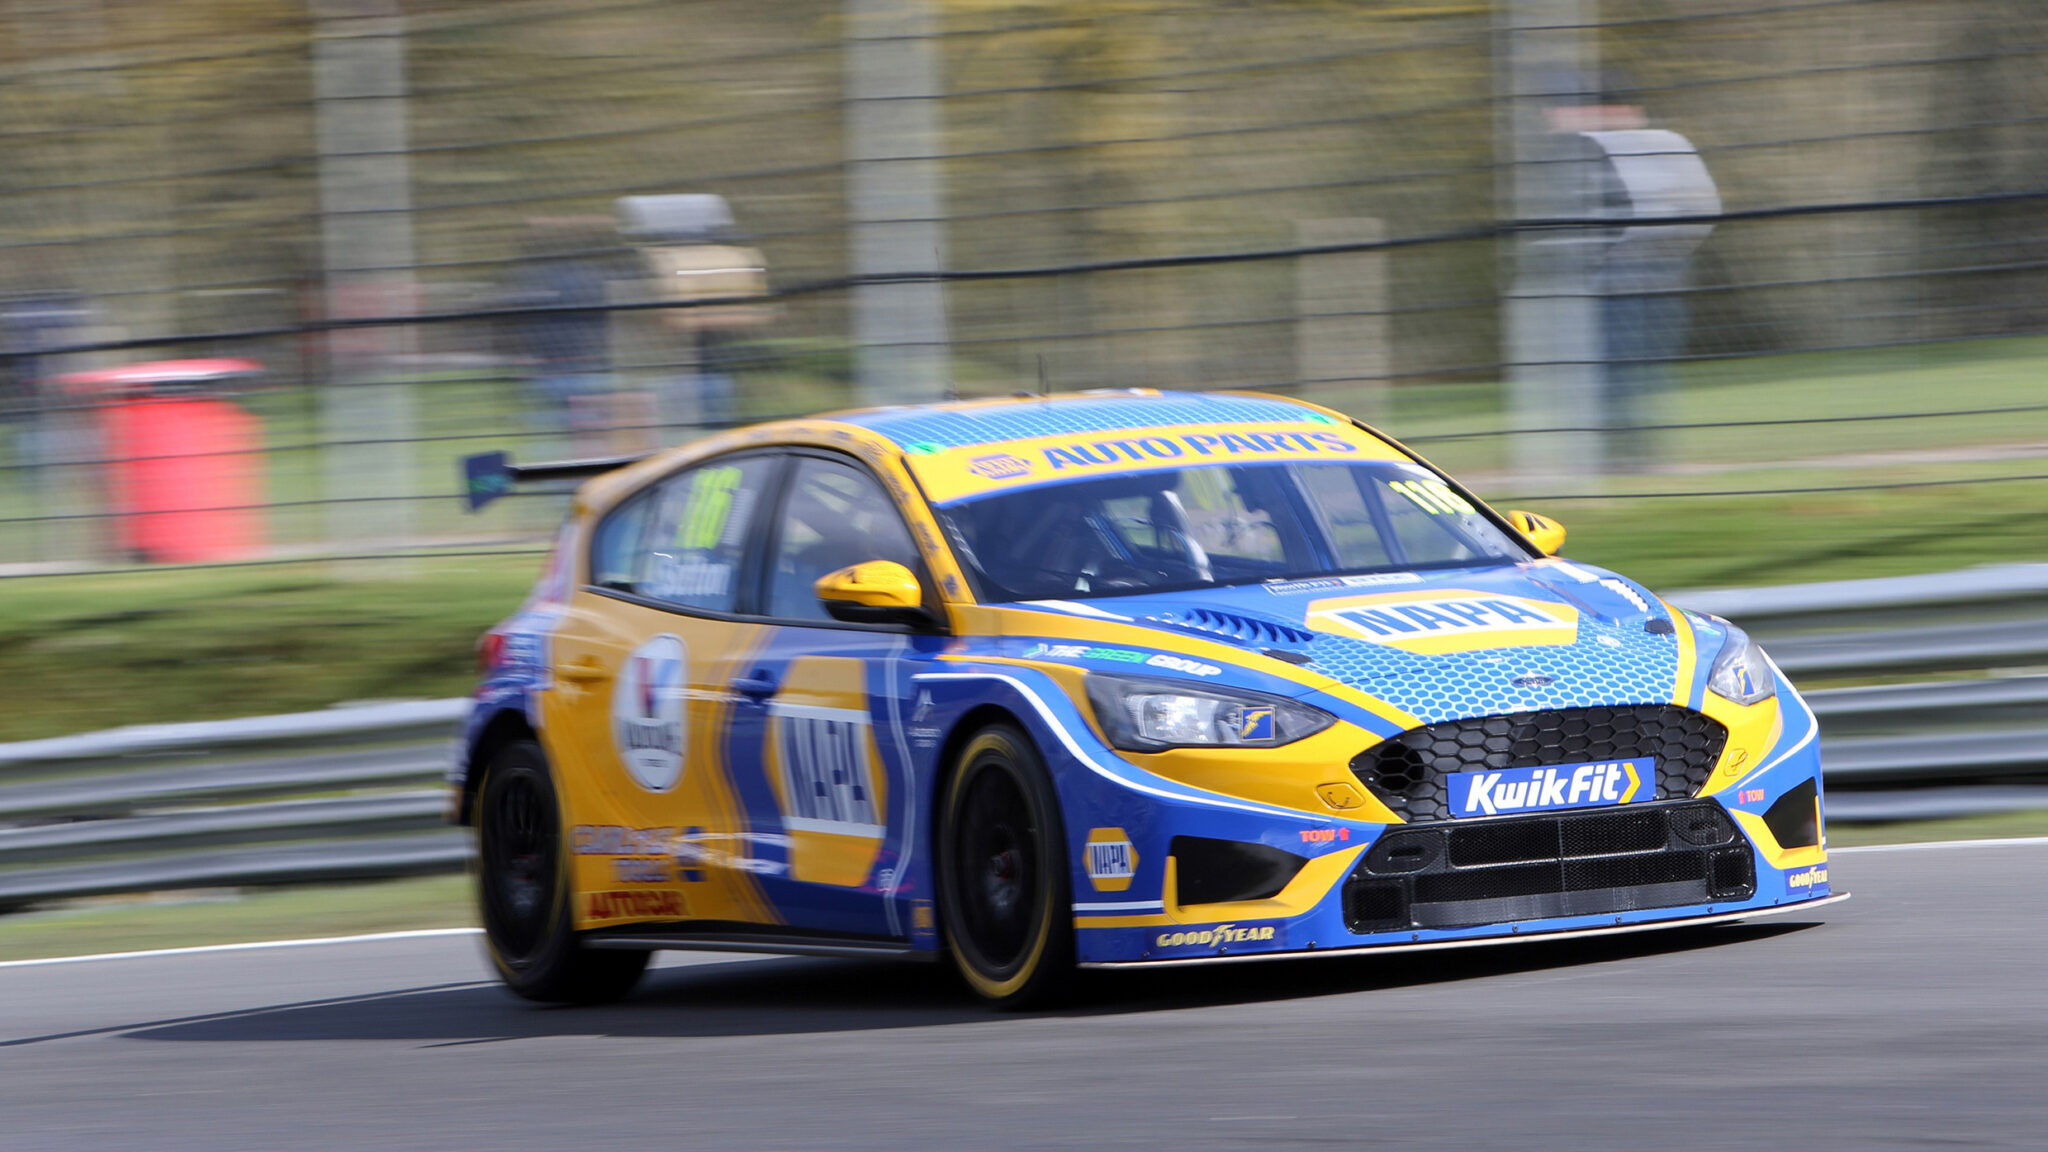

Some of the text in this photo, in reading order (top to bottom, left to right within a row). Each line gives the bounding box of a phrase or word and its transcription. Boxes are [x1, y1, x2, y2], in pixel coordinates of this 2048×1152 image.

[1042, 436, 1183, 469] AUTO
[1180, 431, 1358, 456] PARTS
[1336, 600, 1554, 636] NAPA
[1145, 654, 1222, 677] GROUP
[1746, 789, 1765, 802] TOW
[1299, 829, 1336, 842] TOW
[1156, 923, 1275, 948] GOODYEAR
